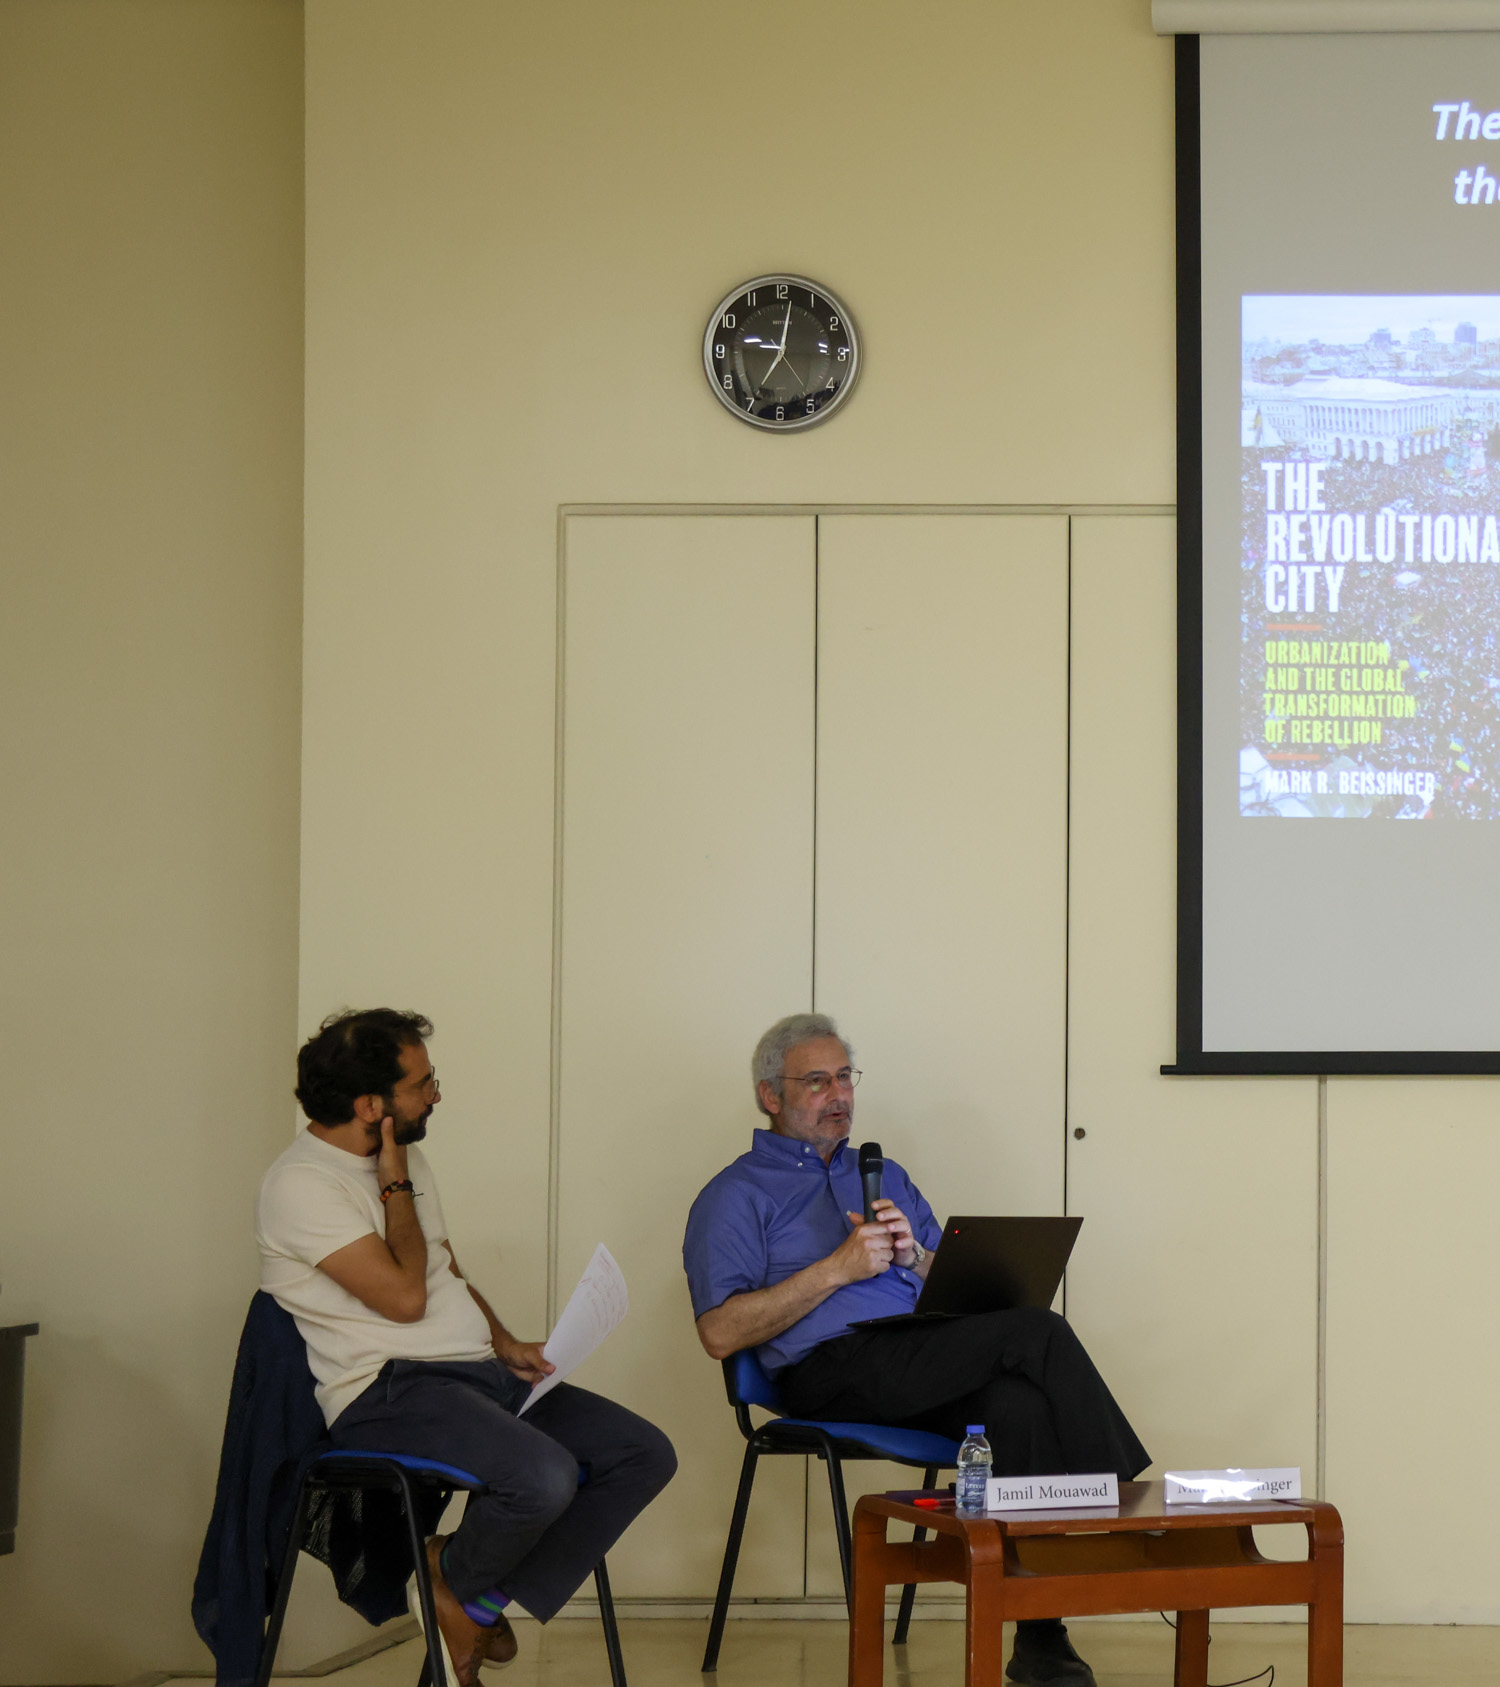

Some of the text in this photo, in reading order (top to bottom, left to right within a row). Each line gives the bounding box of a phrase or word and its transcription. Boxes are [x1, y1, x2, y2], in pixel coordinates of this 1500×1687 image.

[747, 292, 756, 306] 11
[776, 285, 789, 300] 12
[722, 314, 736, 329] 10
[830, 317, 839, 331] 2
[715, 344, 725, 359] 9
[837, 347, 846, 362] 3
[723, 375, 733, 390] 8
[826, 377, 835, 392] 4
[746, 397, 755, 412] 7
[806, 399, 815, 414] 5
[775, 407, 785, 421] 6
[1261, 461, 1326, 511] THE
[1265, 564, 1345, 613] CITY
[1265, 640, 1389, 664] URBANIZATION
[1265, 668, 1405, 692] AND THE GLOBAL
[1263, 694, 1416, 718] TRANSFORMATION
[1264, 720, 1382, 744] OF REBELLION
[1266, 771, 1436, 796] MARK R. BEISSINGER
[996, 1482, 1108, 1503] Jamil Mouawad
